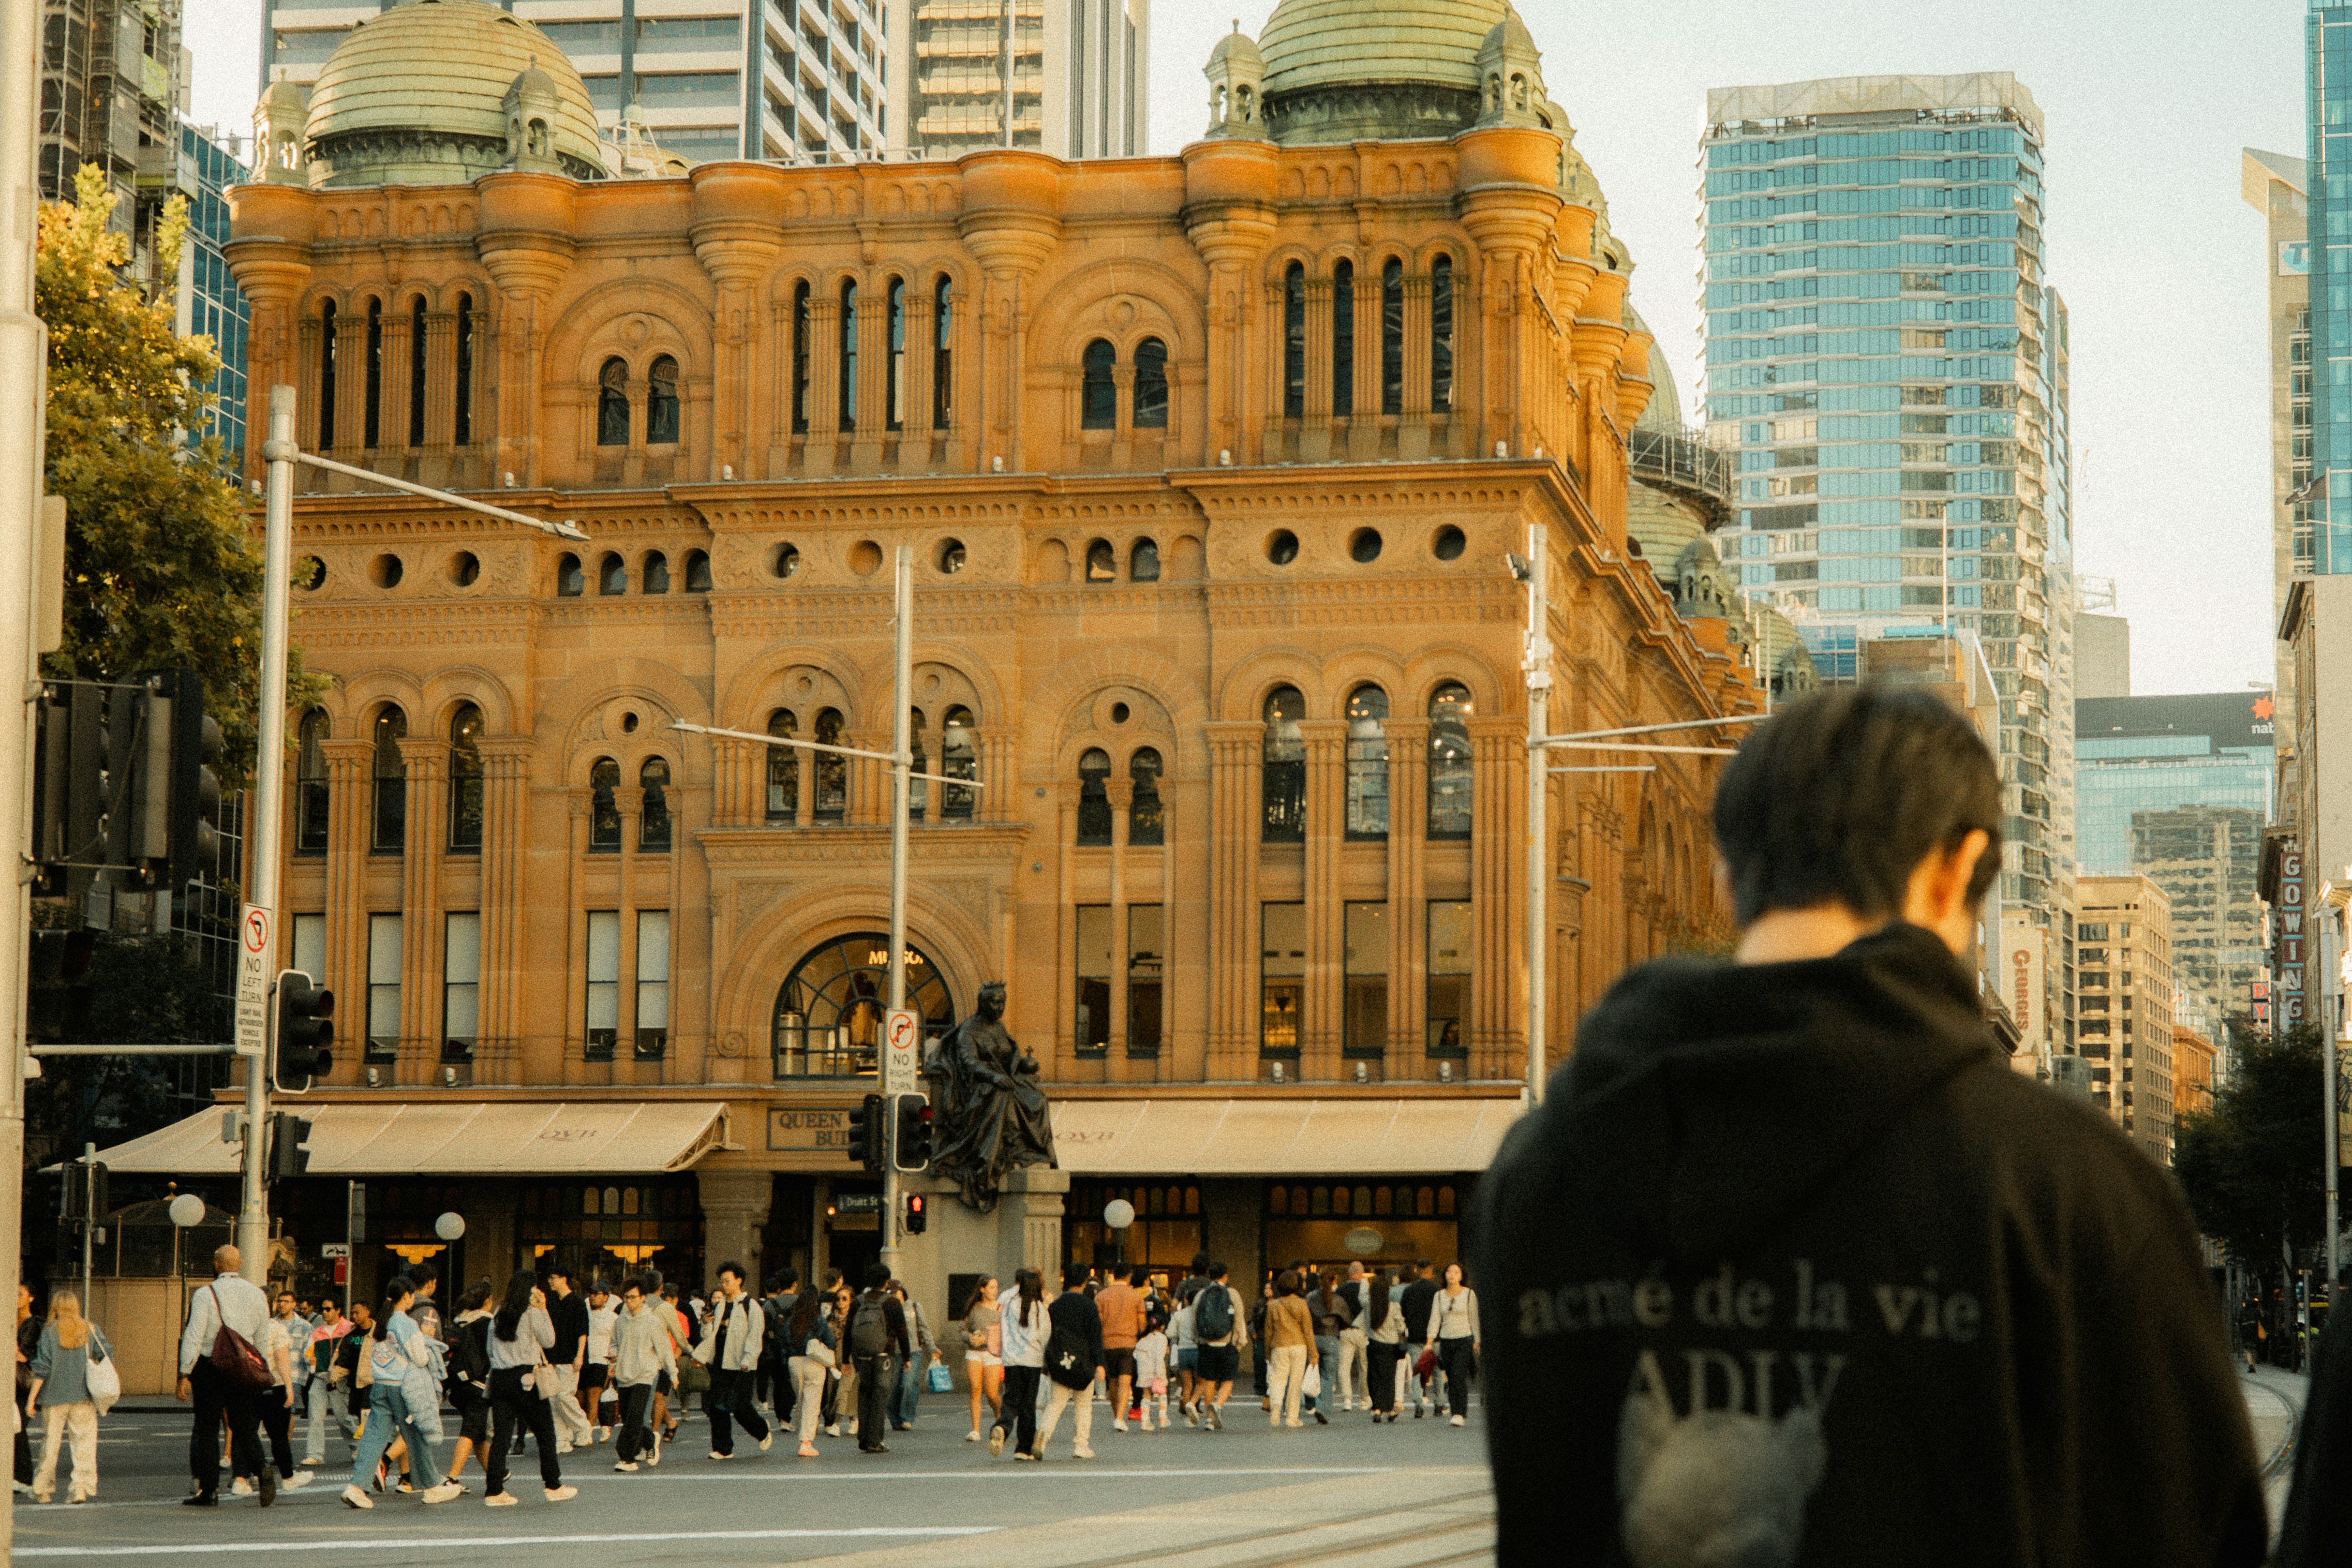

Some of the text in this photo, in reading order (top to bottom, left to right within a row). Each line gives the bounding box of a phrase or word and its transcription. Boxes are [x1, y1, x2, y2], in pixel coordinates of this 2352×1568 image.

[246, 957, 261, 972] NO
[242, 976, 261, 987] LEFT
[241, 990, 261, 1002] TURN
[893, 1053, 909, 1065] NO
[779, 1113, 843, 1129] QUEEN
[816, 1130, 849, 1145] BUI
[1693, 1260, 1774, 1329] de
[1795, 1258, 1850, 1330] la
[1874, 1266, 1982, 1343] vie
